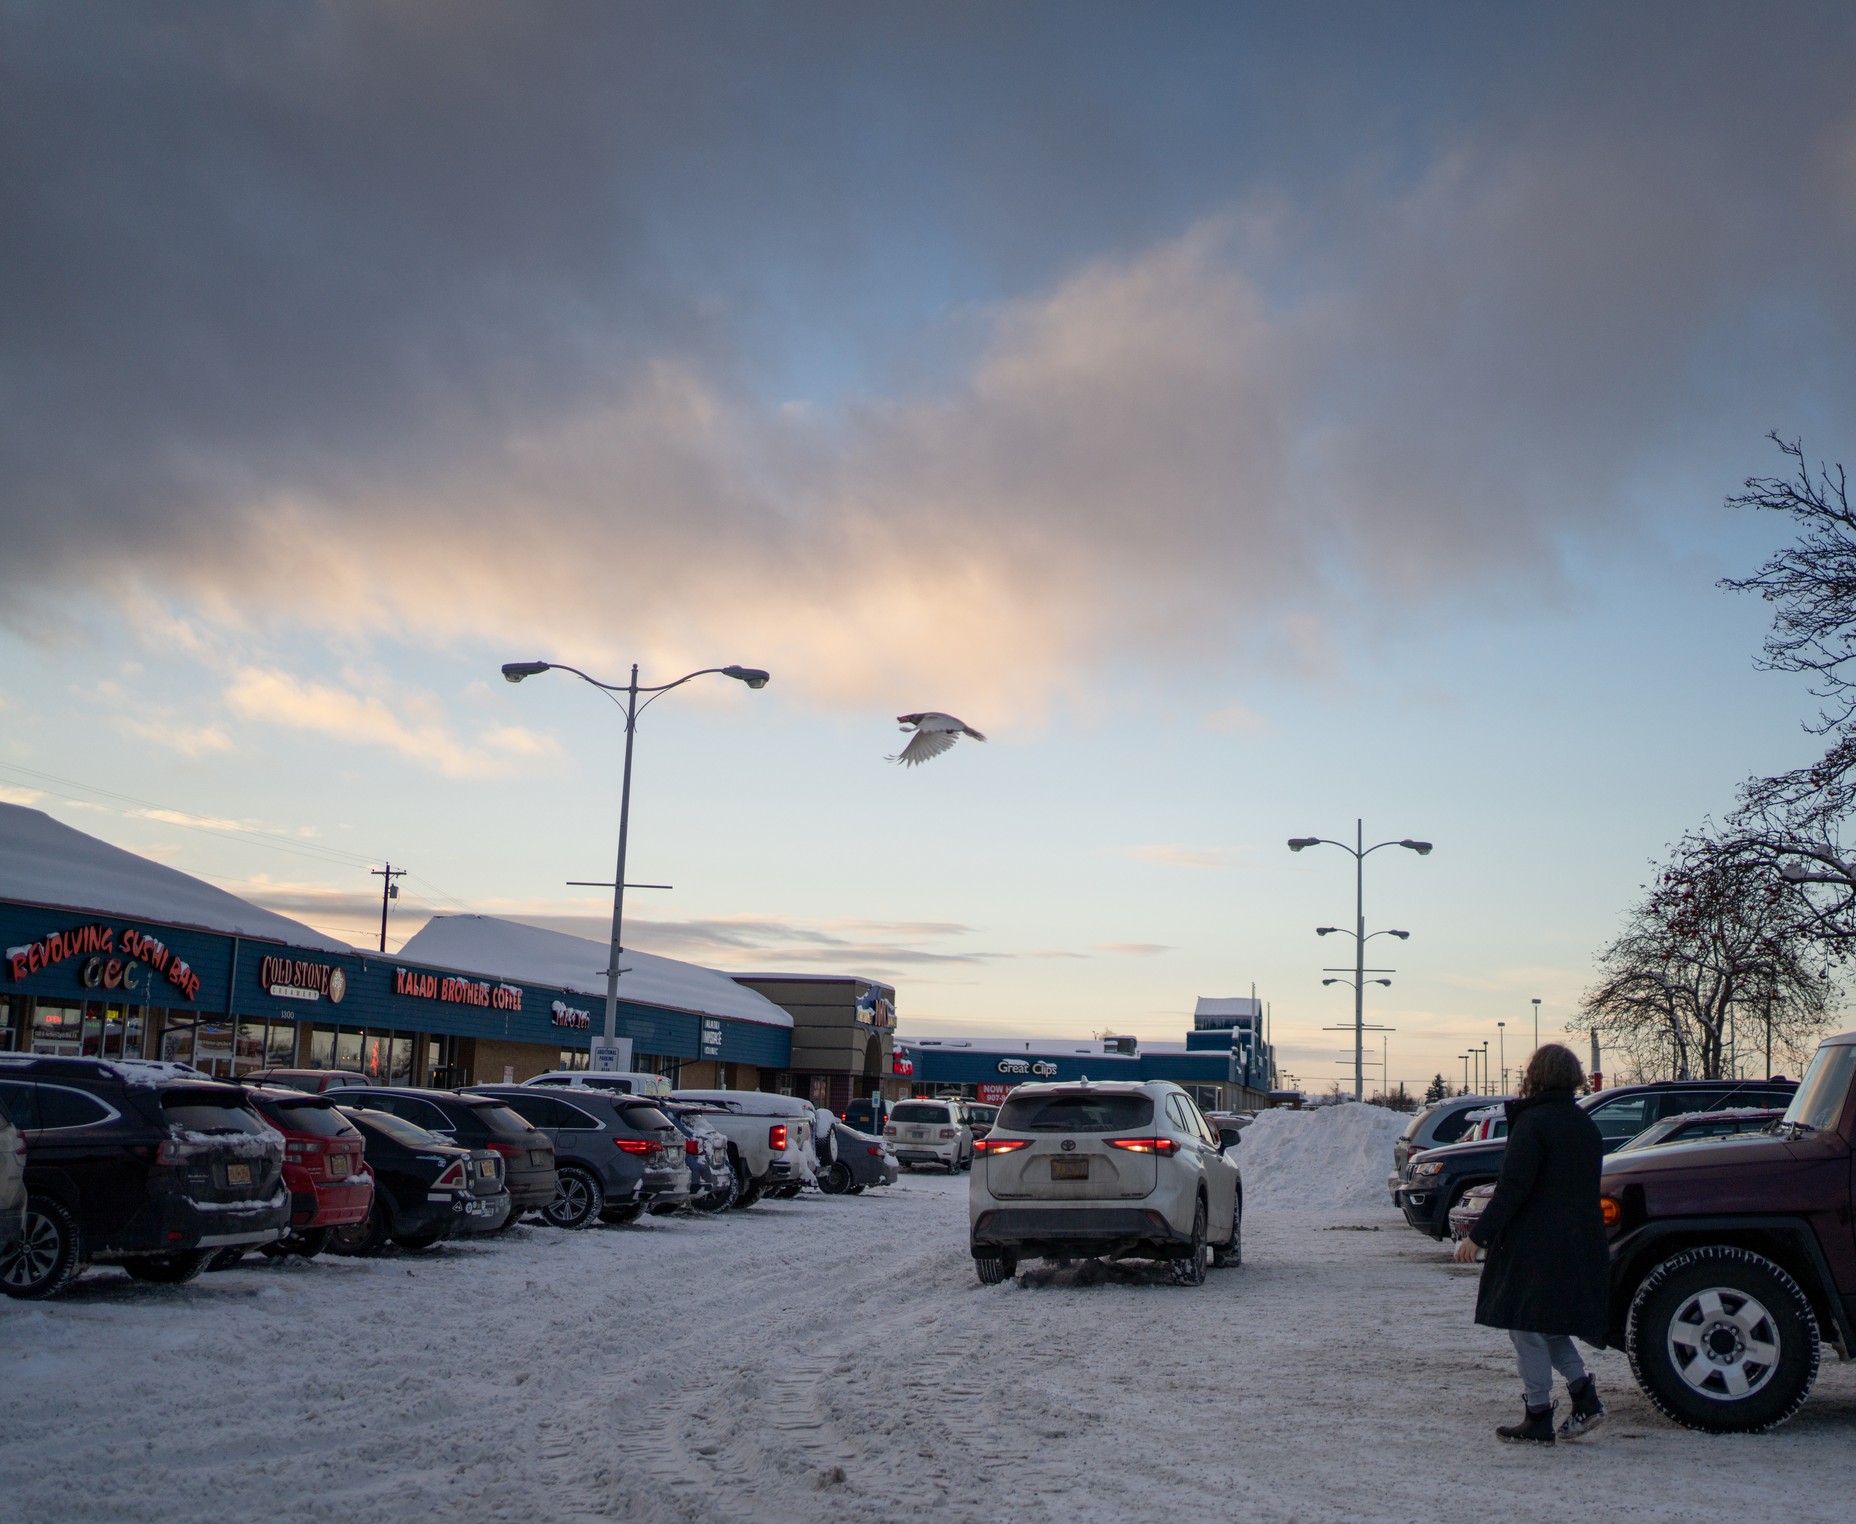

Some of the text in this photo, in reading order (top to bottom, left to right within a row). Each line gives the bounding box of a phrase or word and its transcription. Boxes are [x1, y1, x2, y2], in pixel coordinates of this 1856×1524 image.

[12, 925, 200, 1000] REVOLVING SUSHI BAR
[262, 955, 330, 996] COLD STONE
[272, 986, 318, 998] CREAMERY
[396, 969, 522, 1011] KALADI BROTHERS COFFEE
[997, 1061, 1057, 1078] Great Clips
[983, 1084, 1004, 1093] NOW
[986, 1094, 1006, 1102] 907-9
